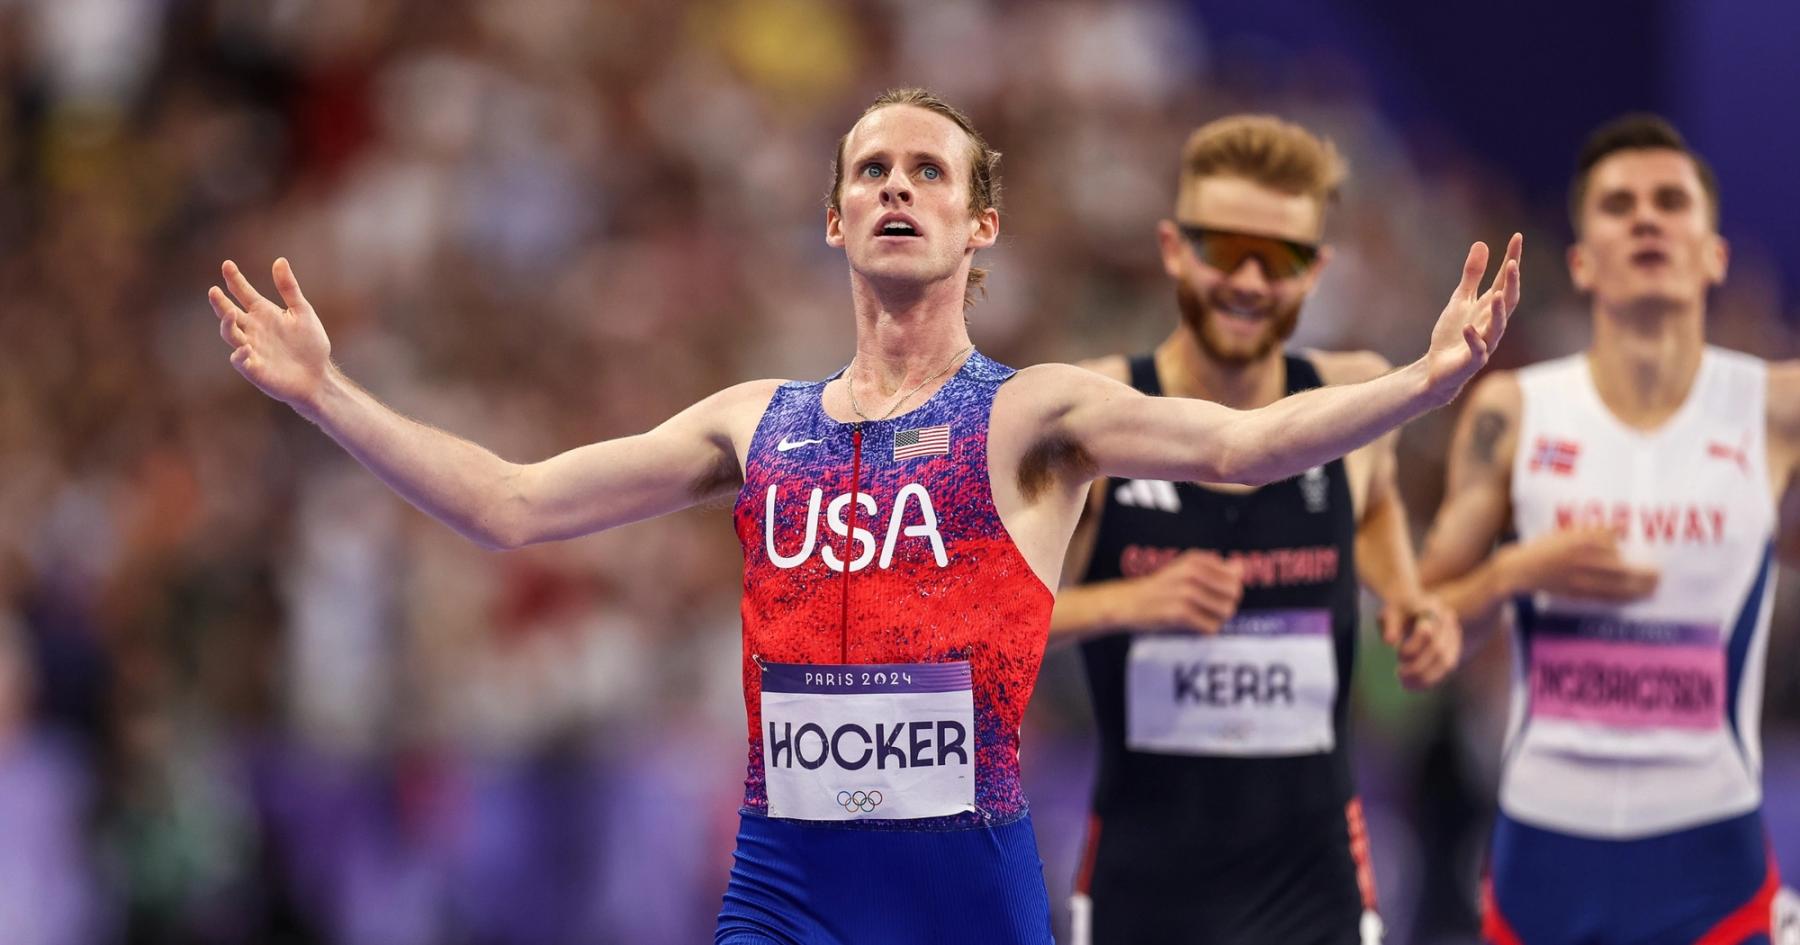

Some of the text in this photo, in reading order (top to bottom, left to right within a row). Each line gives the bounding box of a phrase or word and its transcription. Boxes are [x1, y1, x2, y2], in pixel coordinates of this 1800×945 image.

[766, 483, 948, 572] USA
[861, 672, 912, 686] 2024
[1173, 662, 1294, 706] KERR
[769, 720, 968, 770] HOCKER
